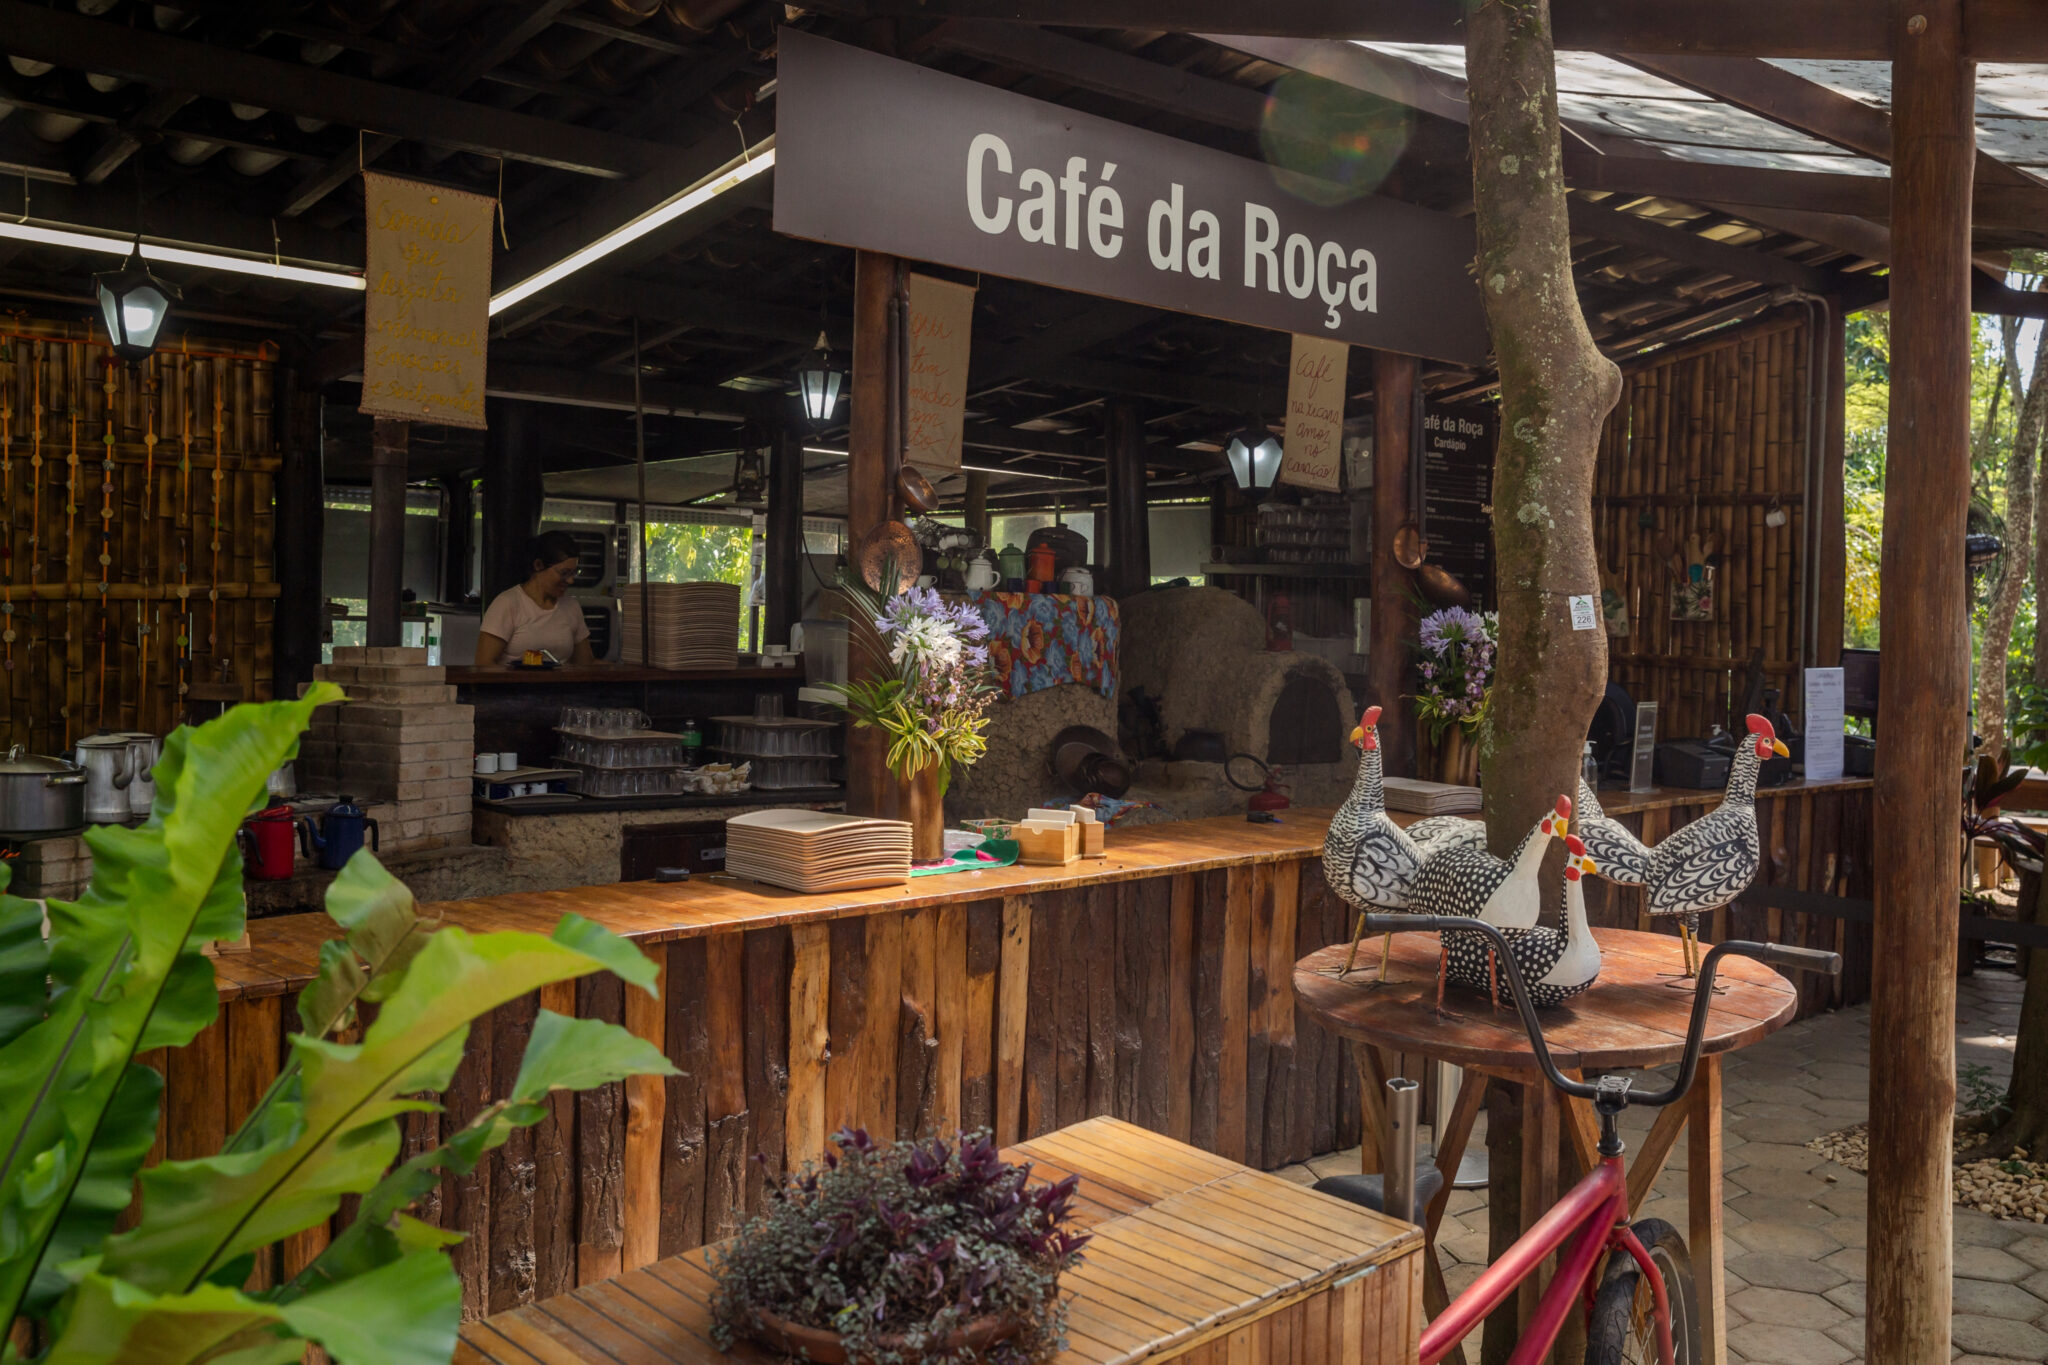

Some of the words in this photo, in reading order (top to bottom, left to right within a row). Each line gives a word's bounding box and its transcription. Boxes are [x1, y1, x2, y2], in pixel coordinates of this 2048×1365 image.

[375, 199, 479, 244] Comida
[965, 133, 1124, 259] Café
[1147, 183, 1221, 281] da
[1244, 201, 1379, 330] Roça
[909, 346, 951, 377] tem
[1298, 353, 1334, 399] Café
[1424, 414, 1440, 430] afé
[1443, 416, 1456, 432] da
[1458, 418, 1484, 439] Roça
[1434, 436, 1467, 452] Cardápio
[1577, 615, 1592, 625] 226
